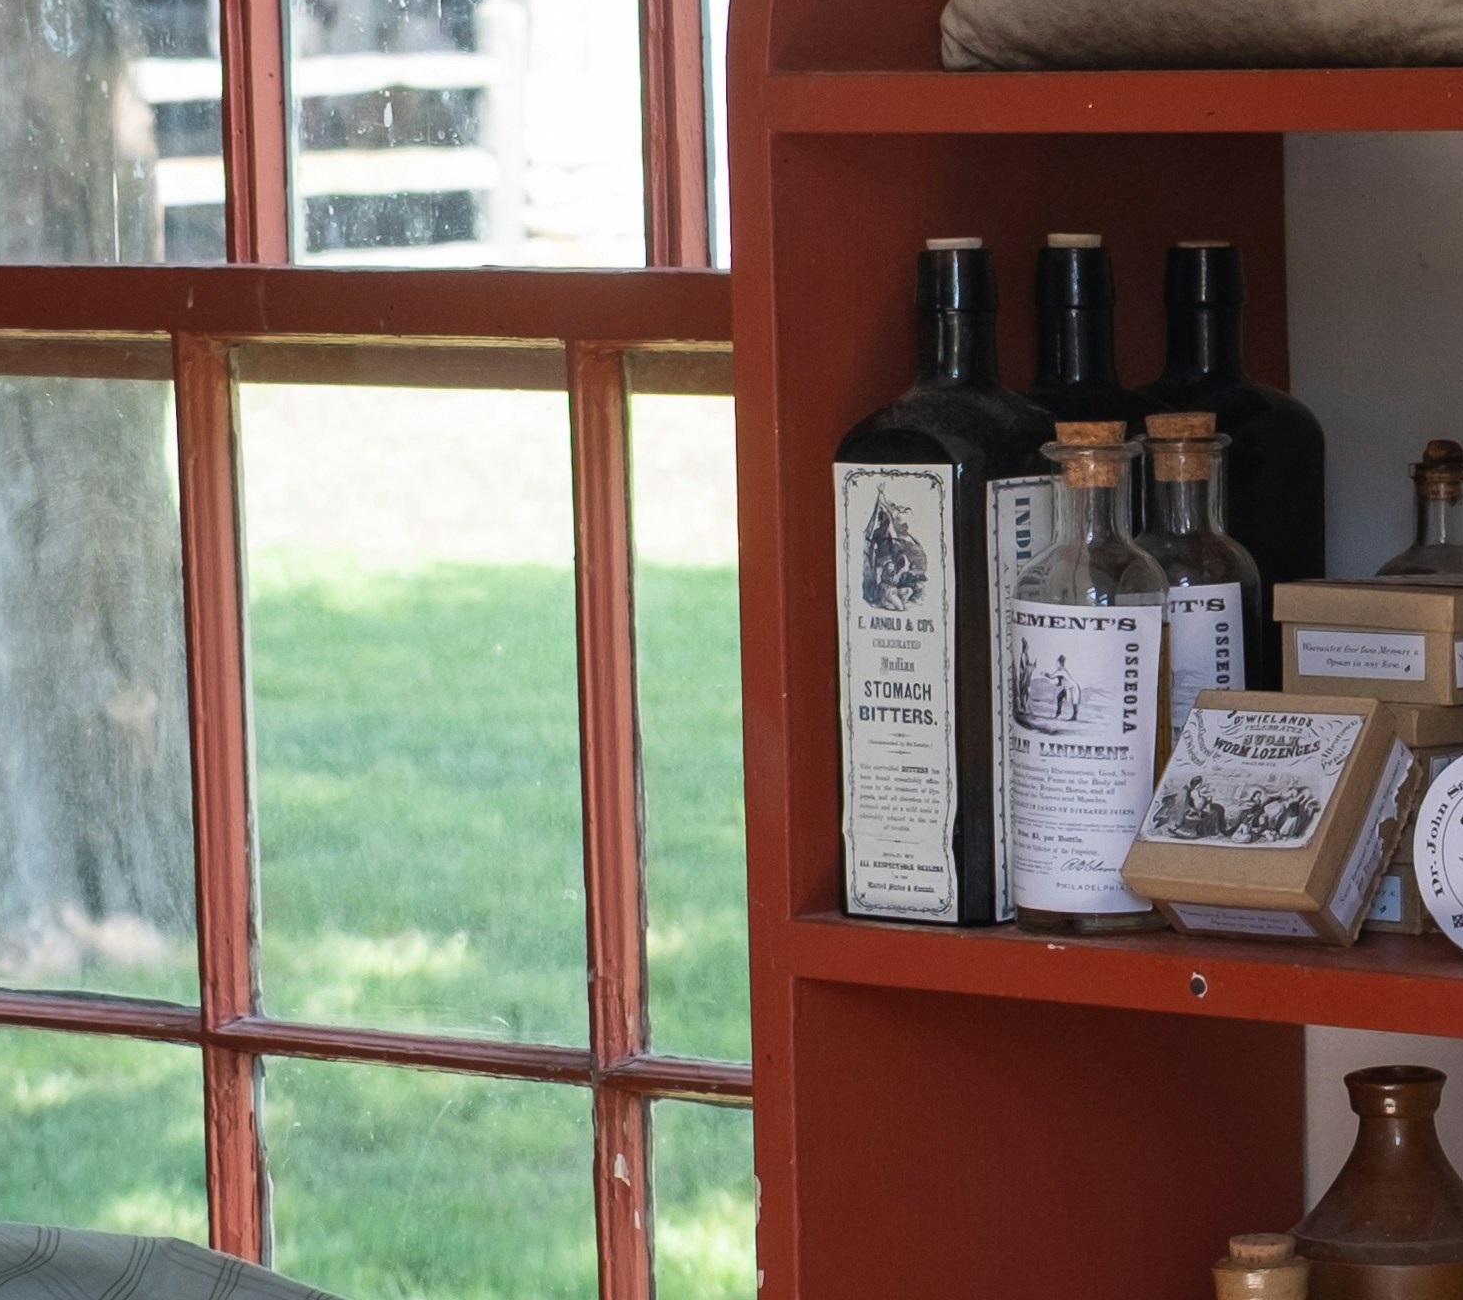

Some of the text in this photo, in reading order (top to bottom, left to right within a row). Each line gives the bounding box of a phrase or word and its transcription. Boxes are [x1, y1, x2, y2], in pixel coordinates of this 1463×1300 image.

[1015, 497, 1032, 575] INDI
[870, 617, 902, 631] ARNOLD
[906, 619, 914, 632] &
[1012, 612, 1136, 631] LEMENT'S
[872, 638, 921, 649] CELEBRATED
[1215, 622, 1231, 690] OSCEO
[1364, 660, 1378, 669] any
[864, 681, 932, 701] STOMACH
[1122, 643, 1139, 734] OSCEOLA
[859, 706, 938, 726] BITTERS.
[1246, 714, 1314, 727] WIELAND'S
[1214, 737, 1320, 759] WORM LOZENGES
[1242, 735, 1300, 746] SUGAR
[1040, 742, 1134, 760] LINIMENT.
[1427, 803, 1449, 854] John
[1430, 861, 1445, 897] Dr.
